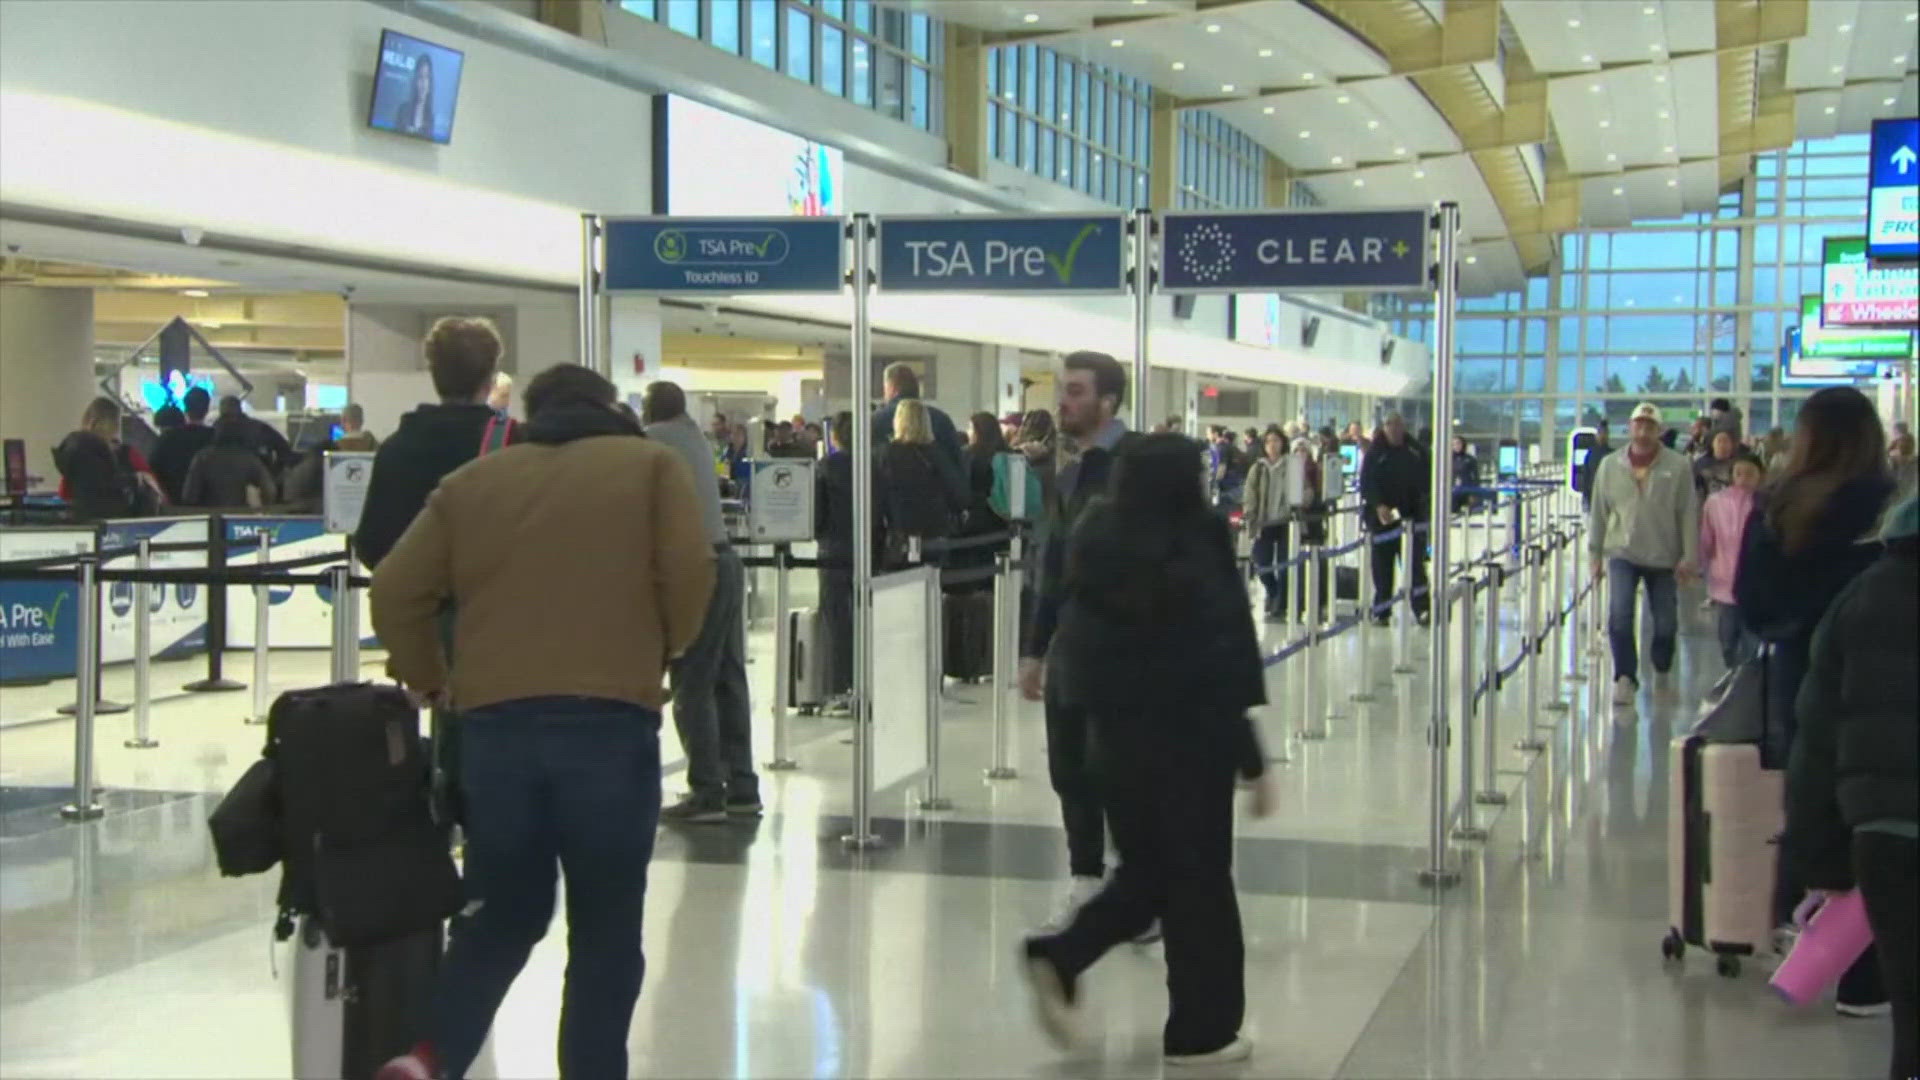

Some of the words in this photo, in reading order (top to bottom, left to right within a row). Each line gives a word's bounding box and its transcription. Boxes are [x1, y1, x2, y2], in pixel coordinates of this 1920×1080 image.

[699, 239, 727, 255] TSA
[729, 239, 754, 255] Pre
[904, 240, 975, 277] TSA
[984, 240, 1045, 277] Pre
[683, 270, 742, 284] Touchless
[744, 271, 759, 284] ID
[11, 603, 43, 628] Pre
[7, 632, 30, 648] With
[31, 631, 55, 647] Ease
